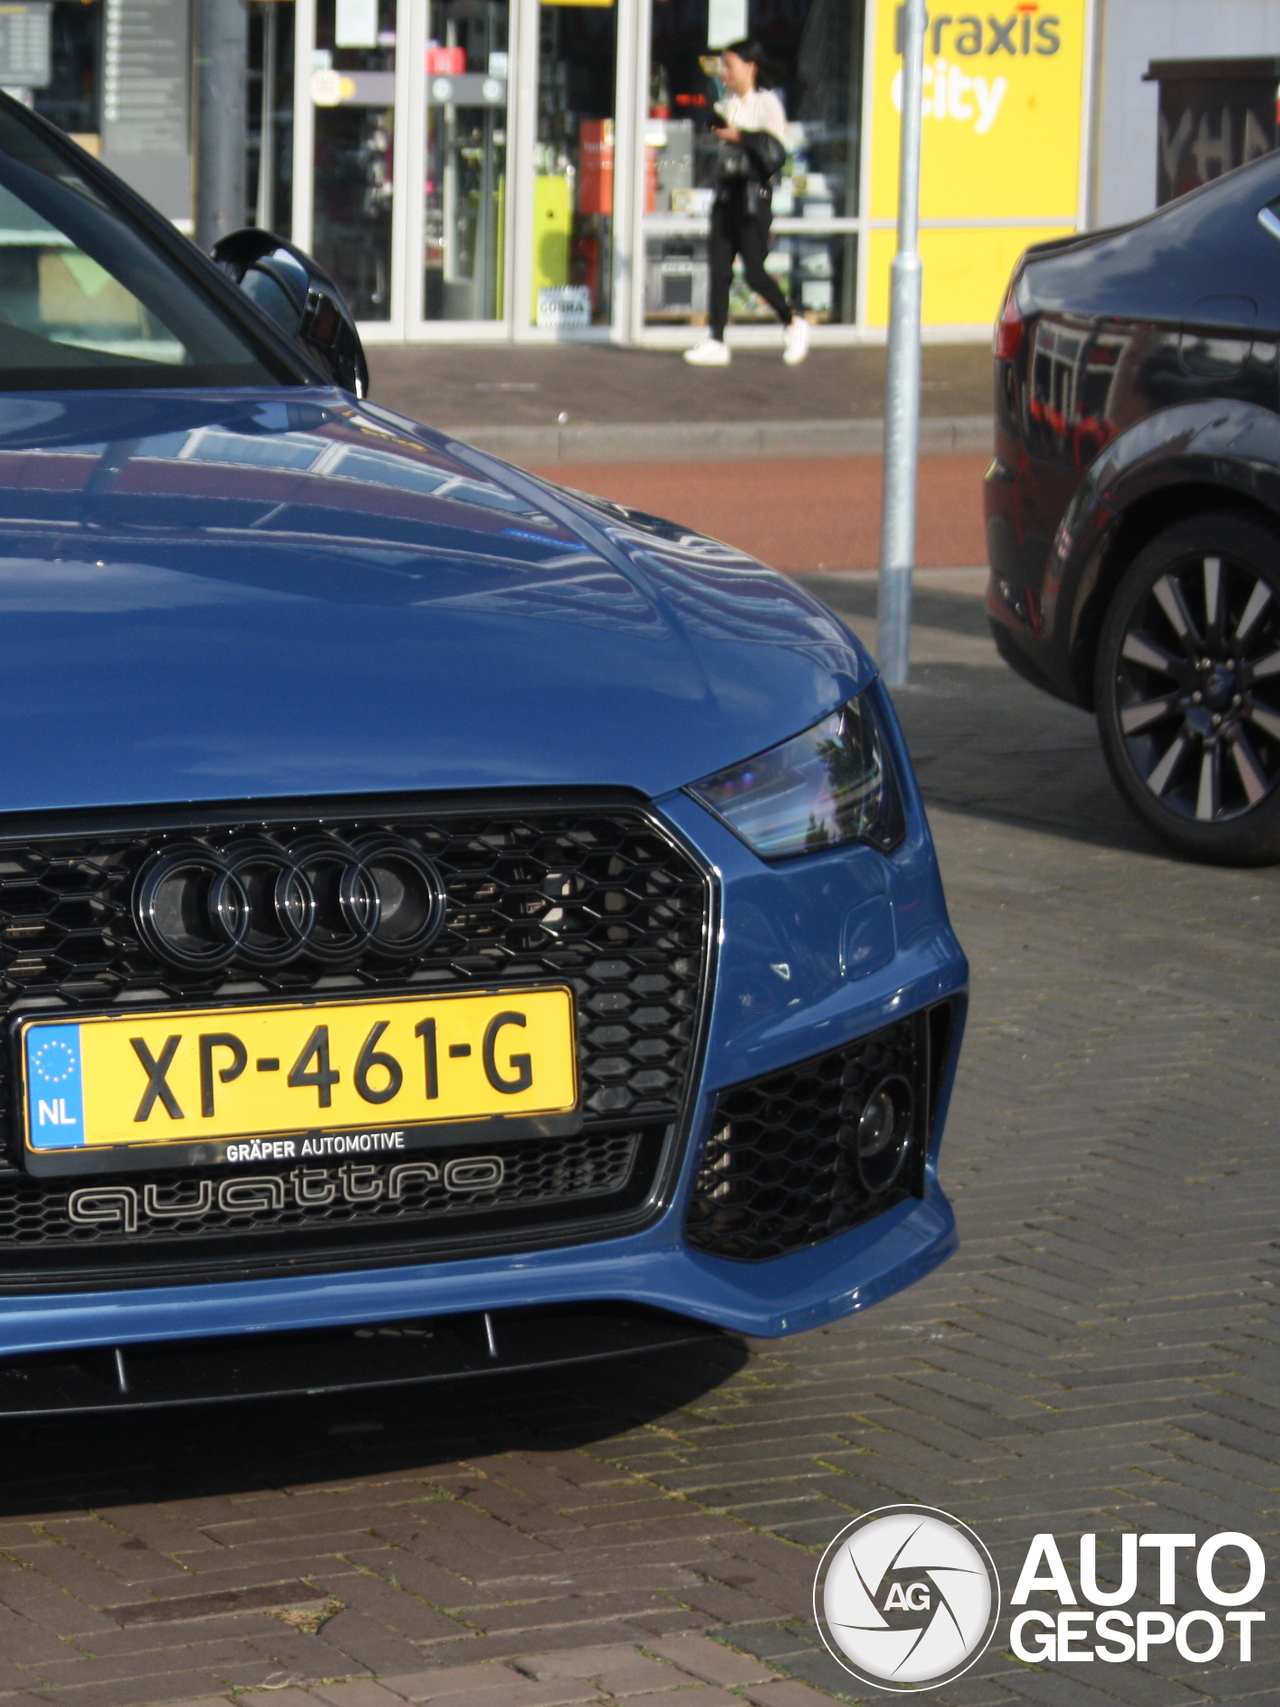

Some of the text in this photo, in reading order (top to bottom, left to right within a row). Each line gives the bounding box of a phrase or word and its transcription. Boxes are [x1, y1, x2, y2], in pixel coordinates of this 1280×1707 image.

[128, 1010, 534, 1123] XP-461-G
[37, 1098, 76, 1127] NL
[226, 1131, 406, 1162] GRÄPER AUTOMOTIVE
[67, 1154, 506, 1233] quattro
